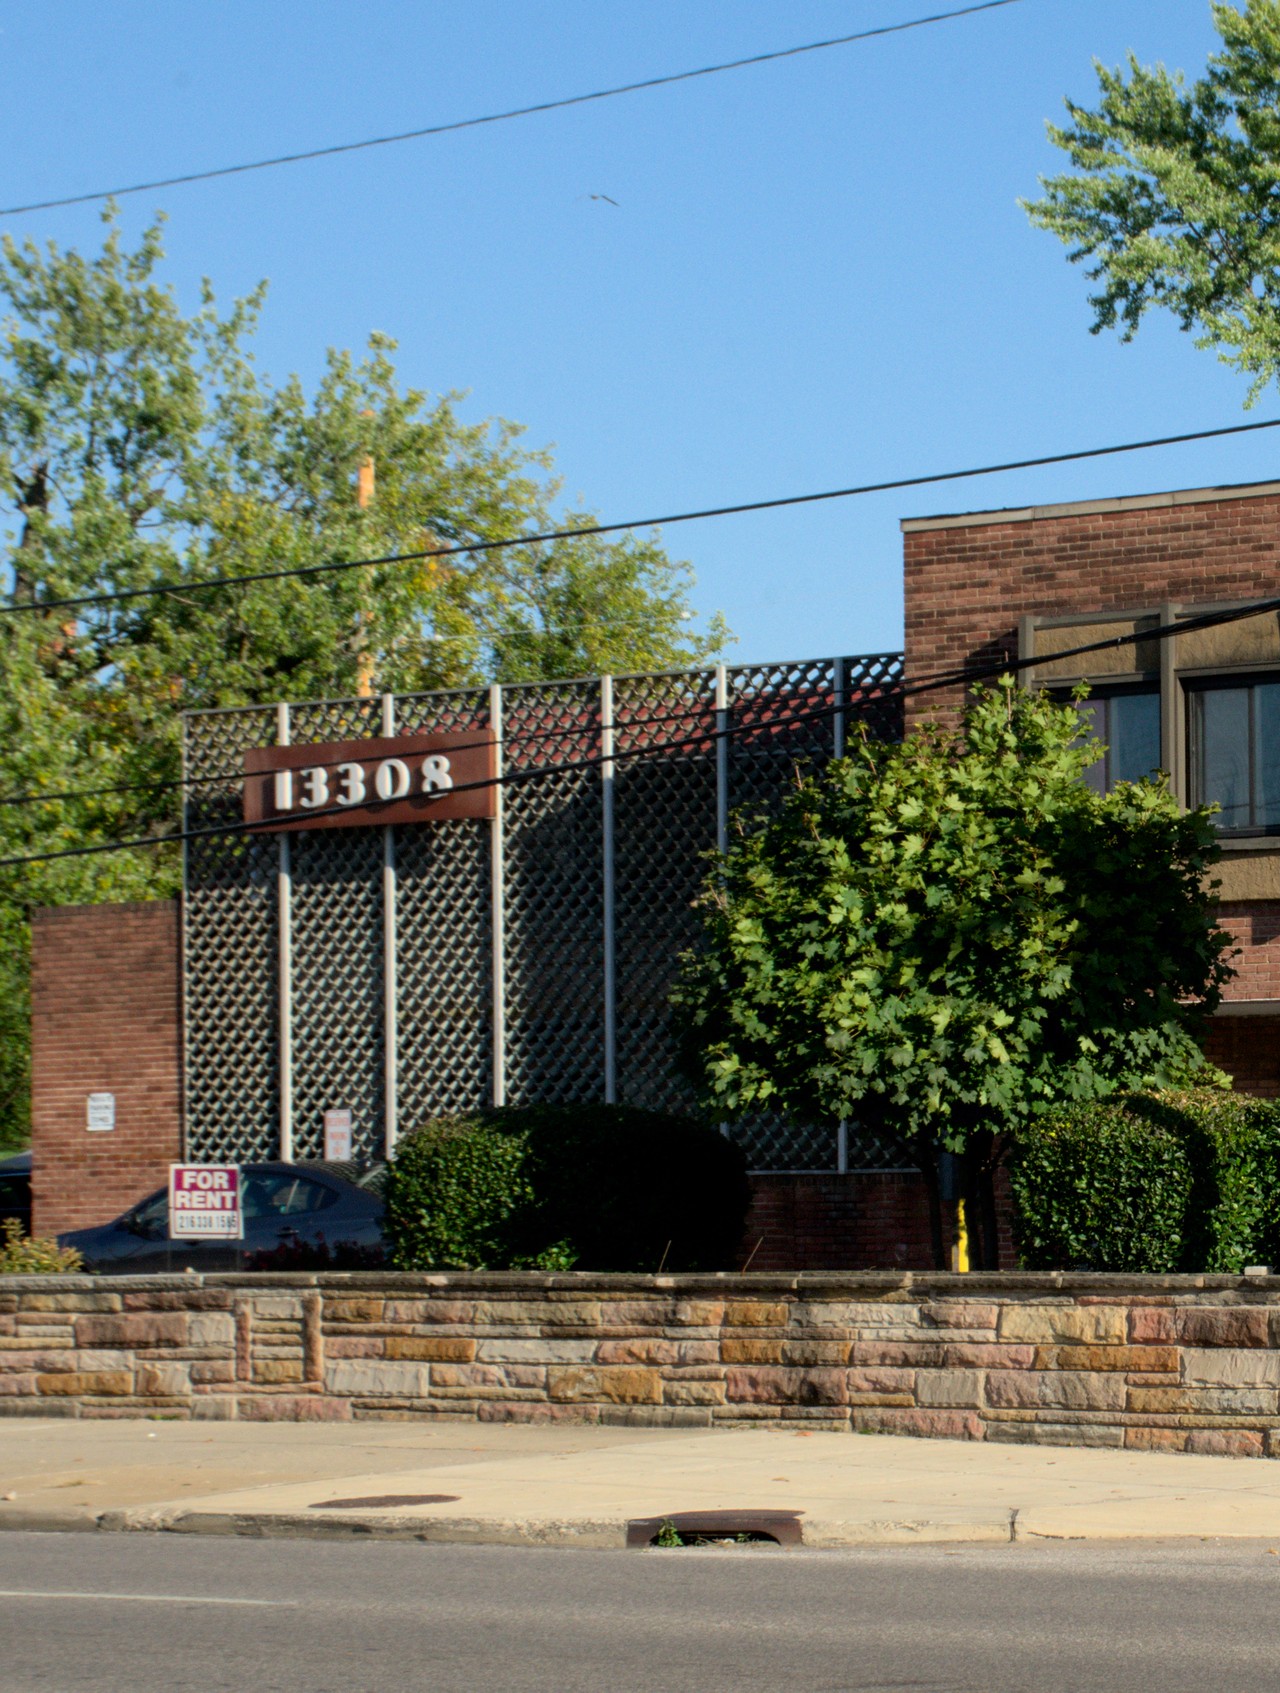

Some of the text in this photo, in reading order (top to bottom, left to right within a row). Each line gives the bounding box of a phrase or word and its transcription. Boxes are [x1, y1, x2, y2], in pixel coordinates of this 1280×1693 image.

[275, 754, 453, 811] 13308
[182, 1171, 229, 1189] FOR
[175, 1190, 236, 1209] RENT
